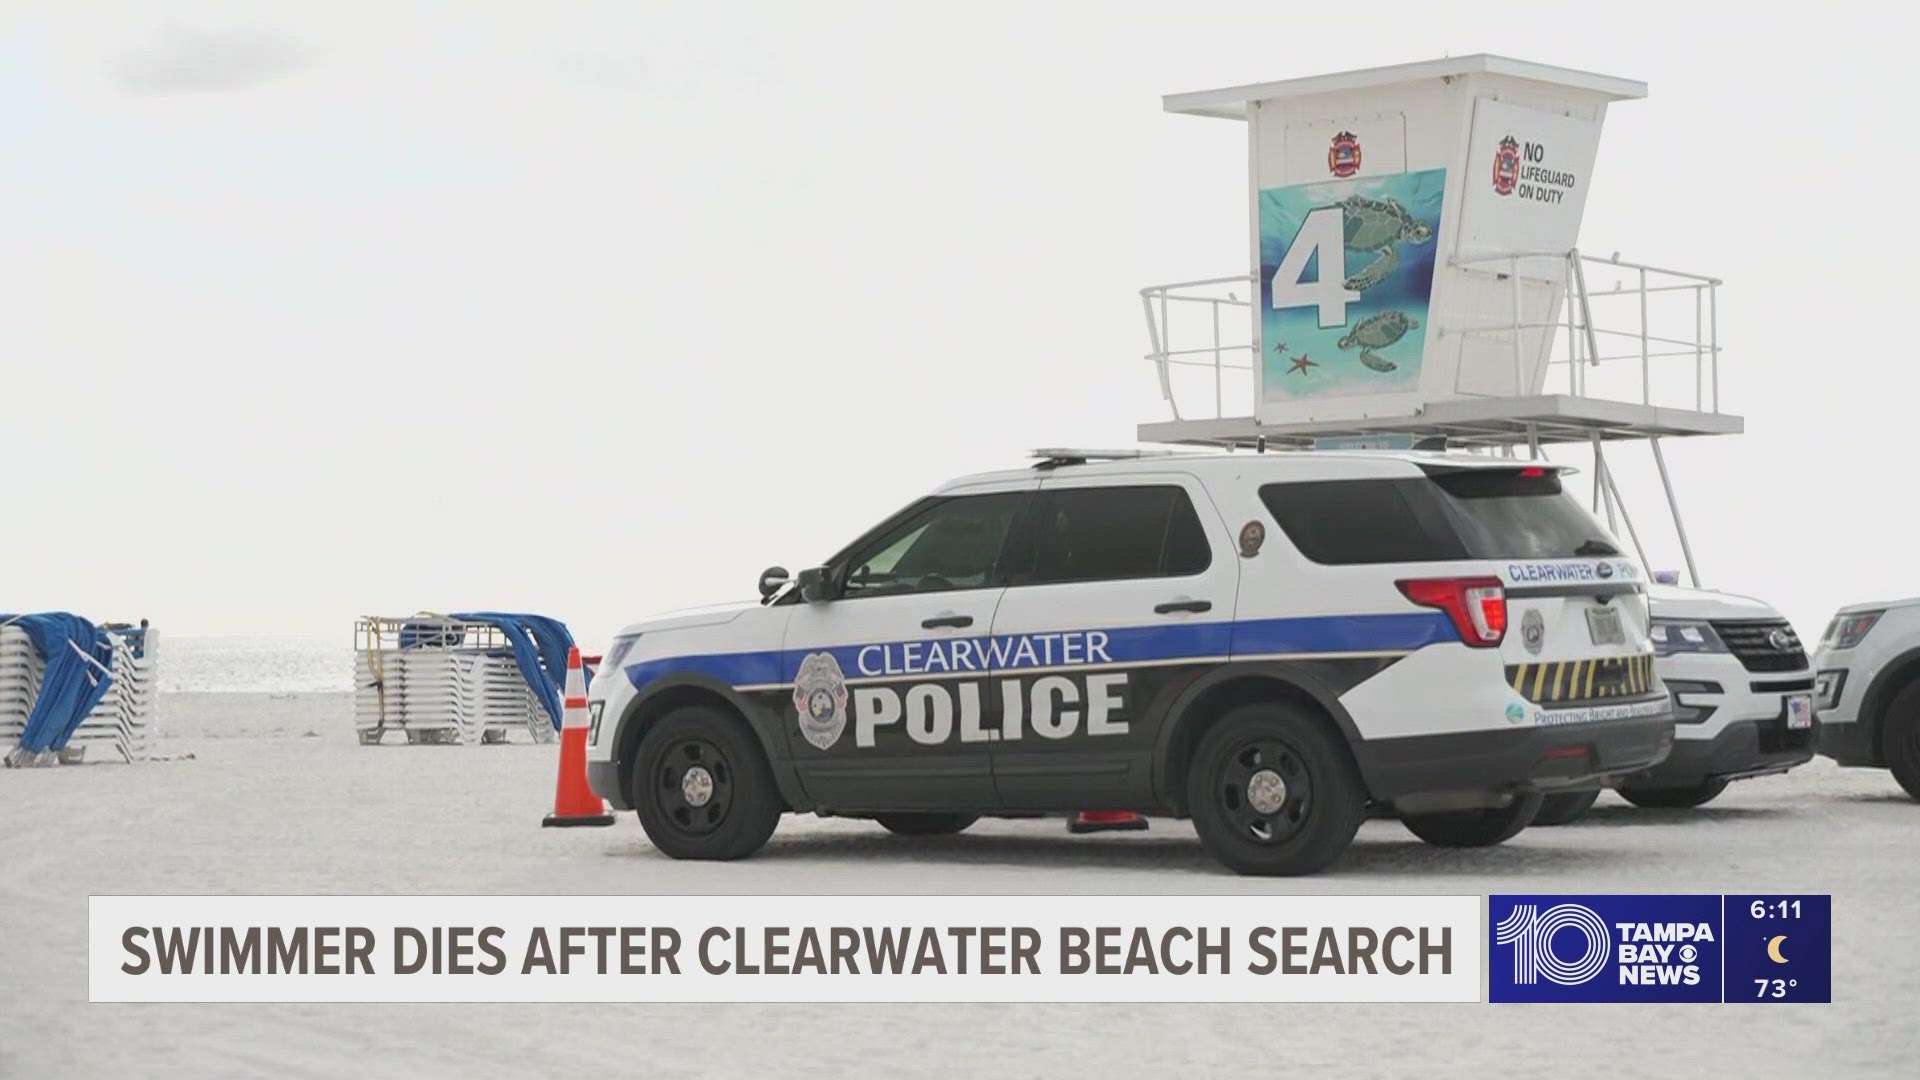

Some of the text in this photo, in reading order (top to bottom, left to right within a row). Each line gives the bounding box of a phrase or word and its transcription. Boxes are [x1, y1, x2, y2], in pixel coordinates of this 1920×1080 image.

[1523, 141, 1544, 163] NO
[1520, 166, 1575, 188] LIFEGUARD
[1518, 183, 1564, 205] ON DUTY
[1271, 205, 1361, 330] 4
[1509, 562, 1594, 582] CLEARWATER
[857, 630, 1112, 677] CLEARWATER
[854, 673, 1130, 749] POLICE
